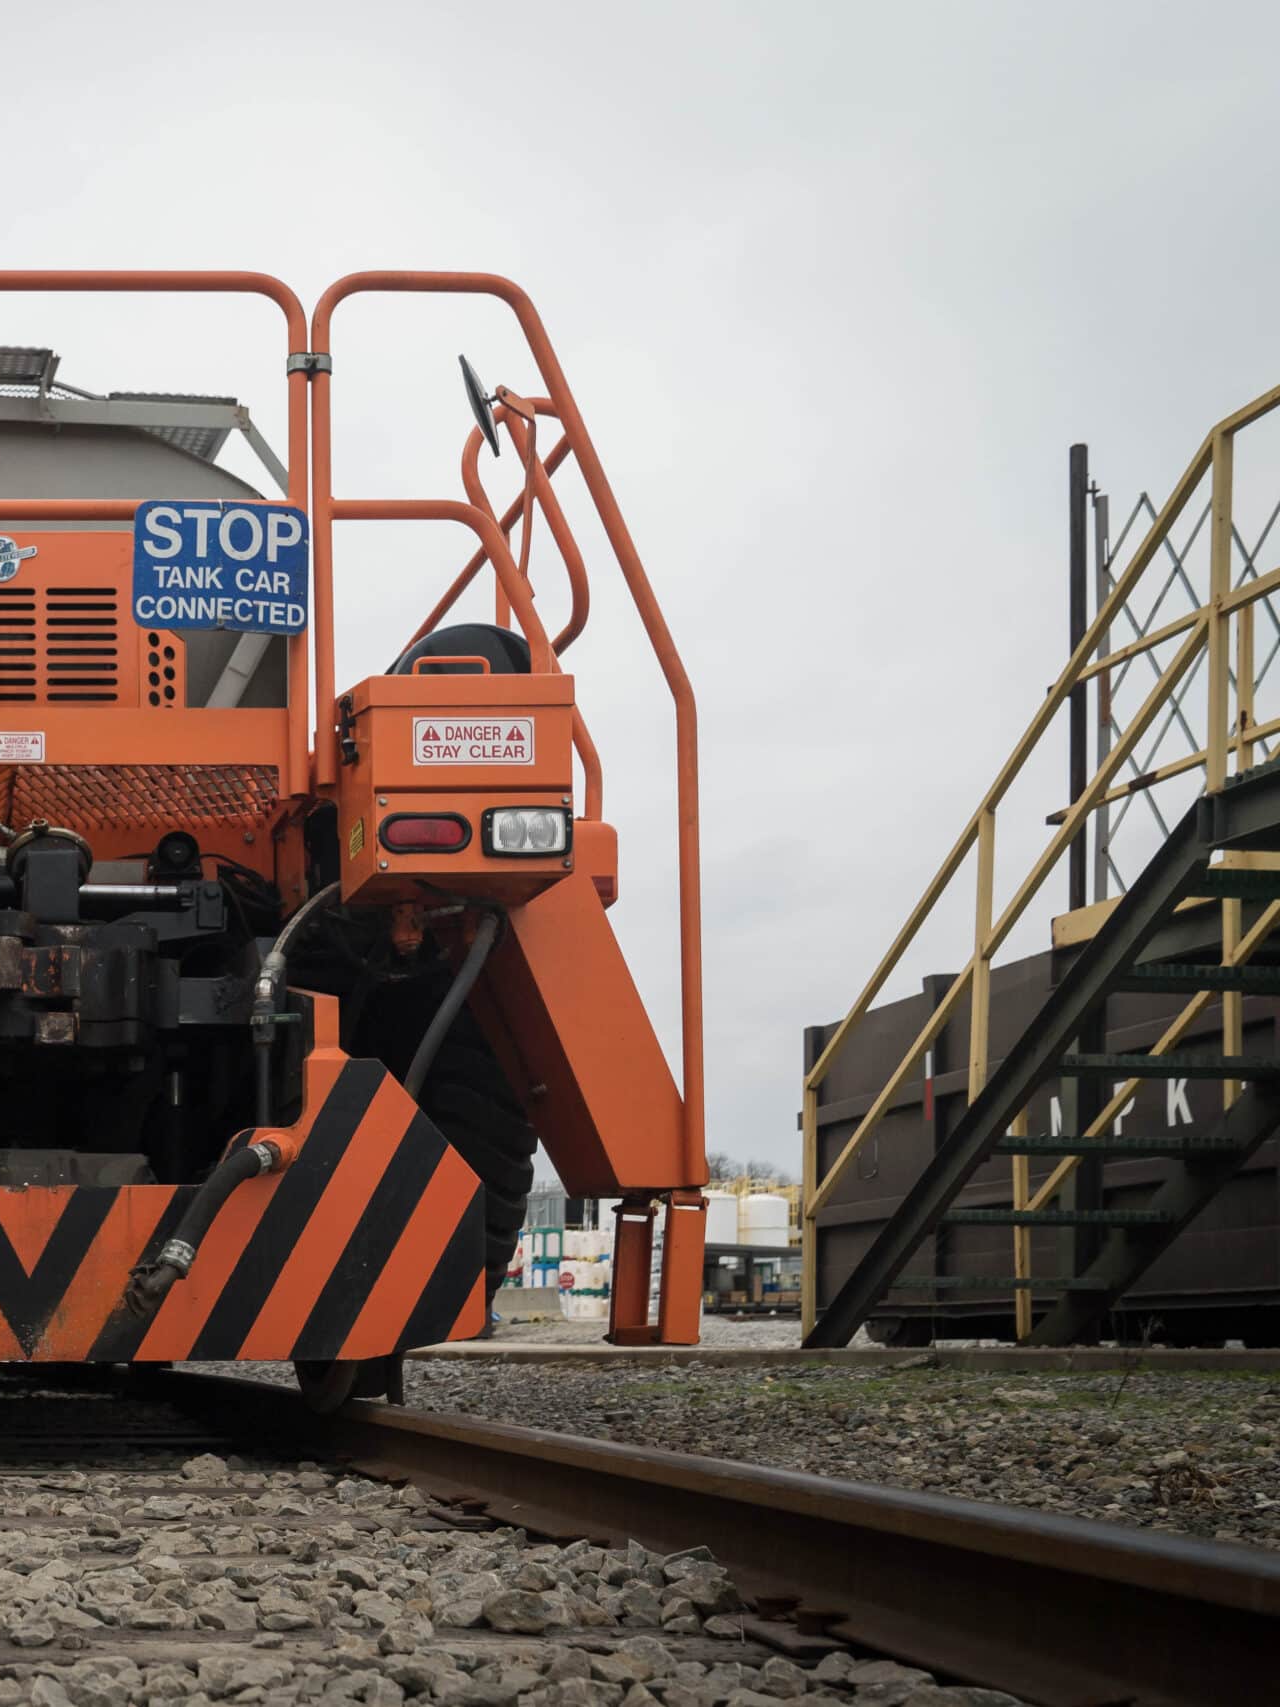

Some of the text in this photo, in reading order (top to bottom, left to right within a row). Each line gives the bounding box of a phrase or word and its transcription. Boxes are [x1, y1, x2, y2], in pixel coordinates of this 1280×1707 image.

[143, 506, 303, 563] STOP
[153, 566, 291, 596] TANK CAR
[135, 595, 305, 627] CONNECTED
[445, 726, 502, 741] DANGER
[422, 745, 525, 759] STAY CLEAR
